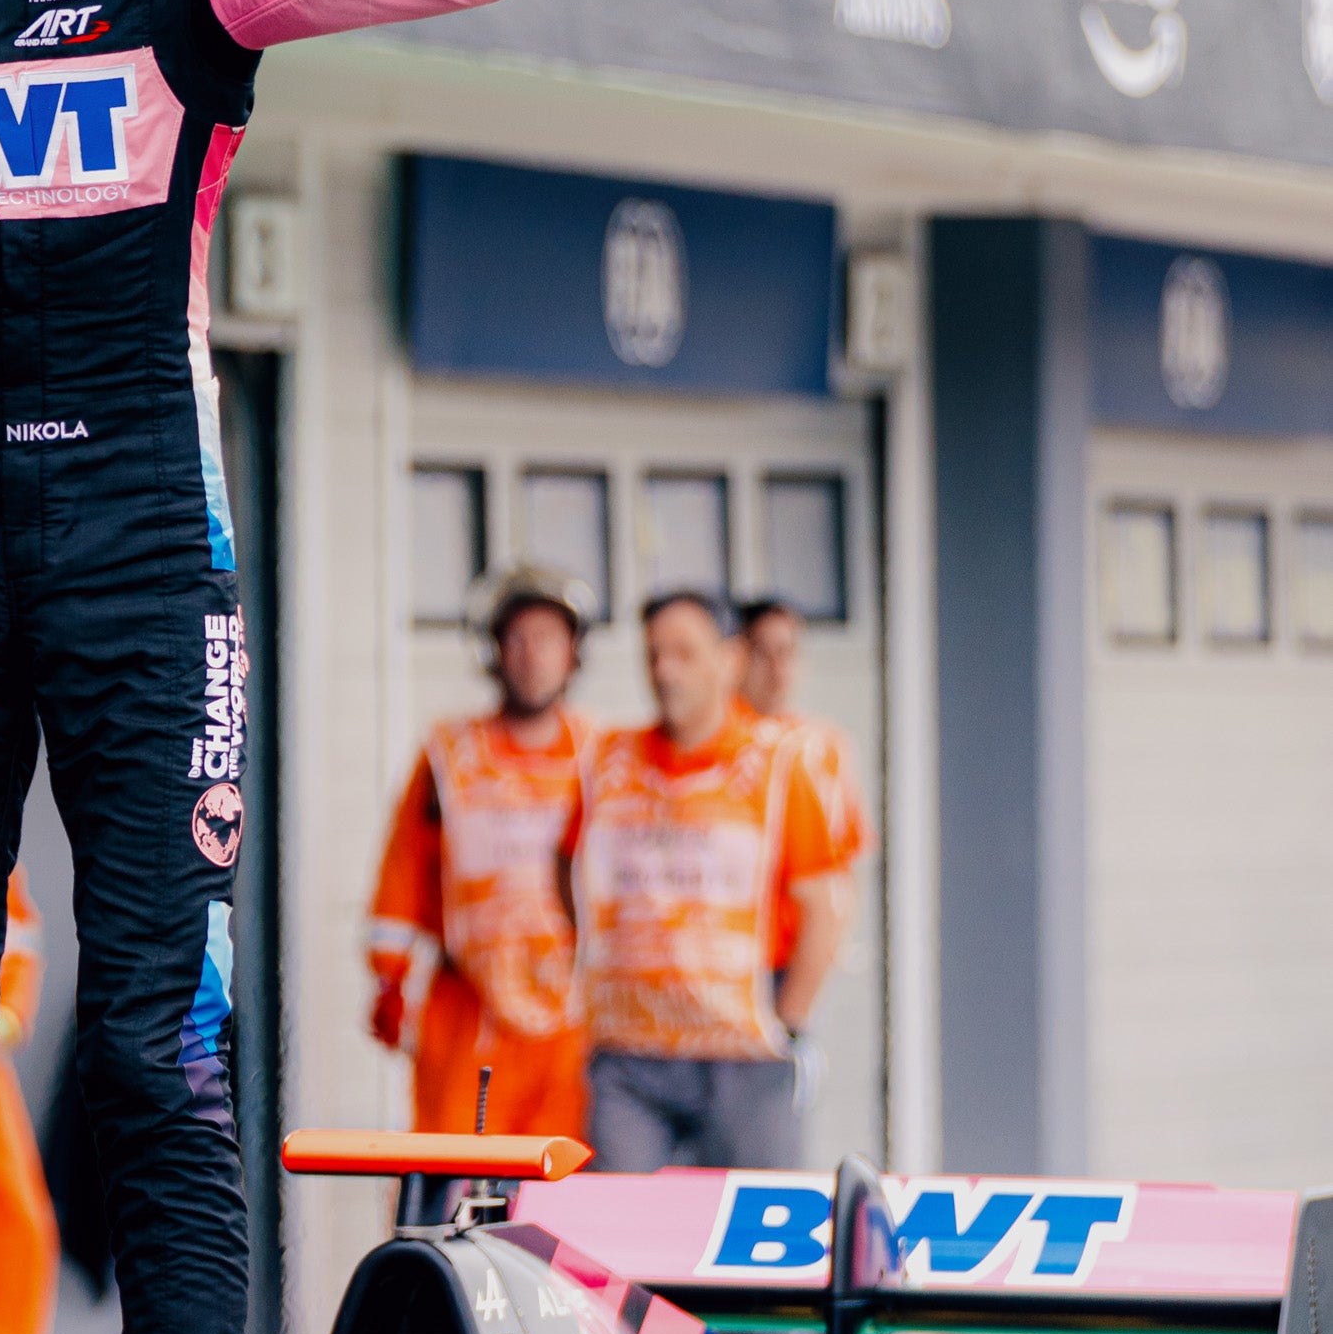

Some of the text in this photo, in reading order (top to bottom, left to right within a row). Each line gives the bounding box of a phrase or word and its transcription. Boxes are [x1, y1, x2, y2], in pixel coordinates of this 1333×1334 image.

[14, 36, 60, 47] GRAND PRIX
[18, 5, 103, 38] ART
[6, 420, 88, 443] NIKOLA
[204, 614, 230, 779] CHANGE
[229, 616, 244, 746] WORLD
[714, 1185, 1124, 1276] BWT
